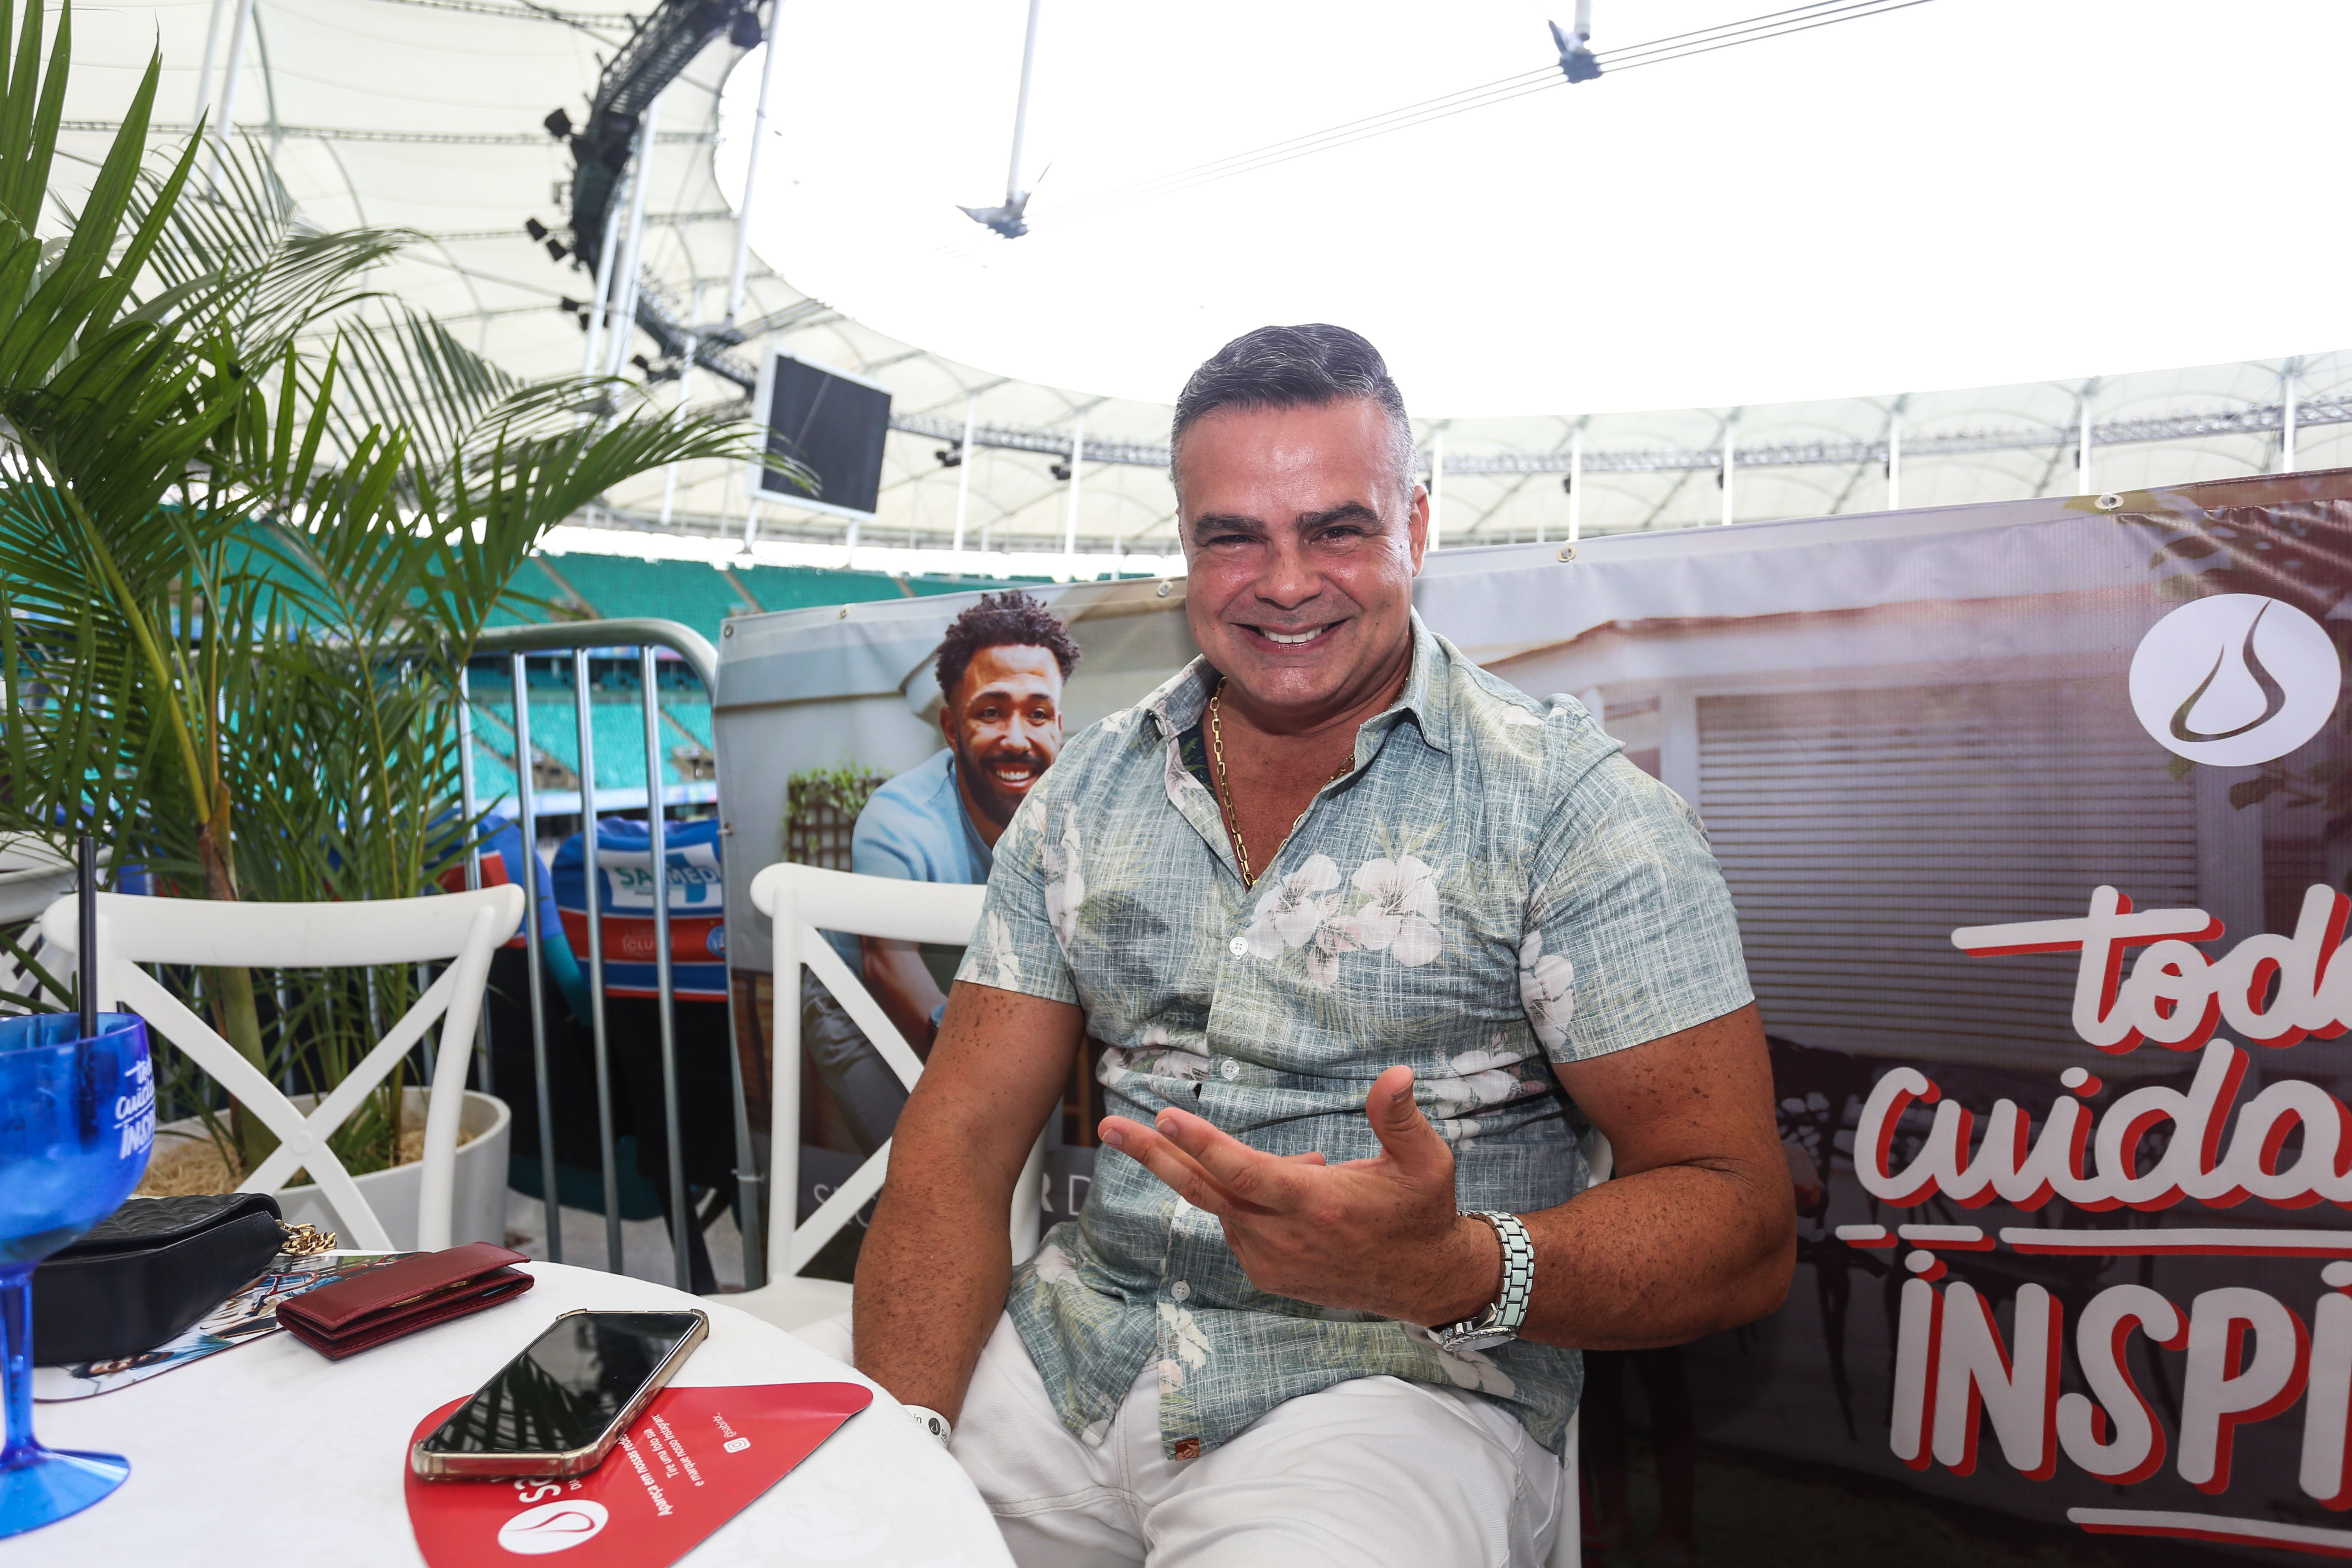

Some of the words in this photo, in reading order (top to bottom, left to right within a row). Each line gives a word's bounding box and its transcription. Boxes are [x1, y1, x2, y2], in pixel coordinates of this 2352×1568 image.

[1951, 884, 2352, 1049] tod
[643, 1428, 656, 1439] sua
[650, 1438, 664, 1452] foto
[669, 1439, 686, 1457] nosso
[627, 1450, 648, 1474] nossas
[657, 1450, 672, 1464] uma
[666, 1464, 679, 1479] Tire
[680, 1457, 701, 1482] marque
[640, 1473, 655, 1486] em
[647, 1485, 674, 1516] Apareça
